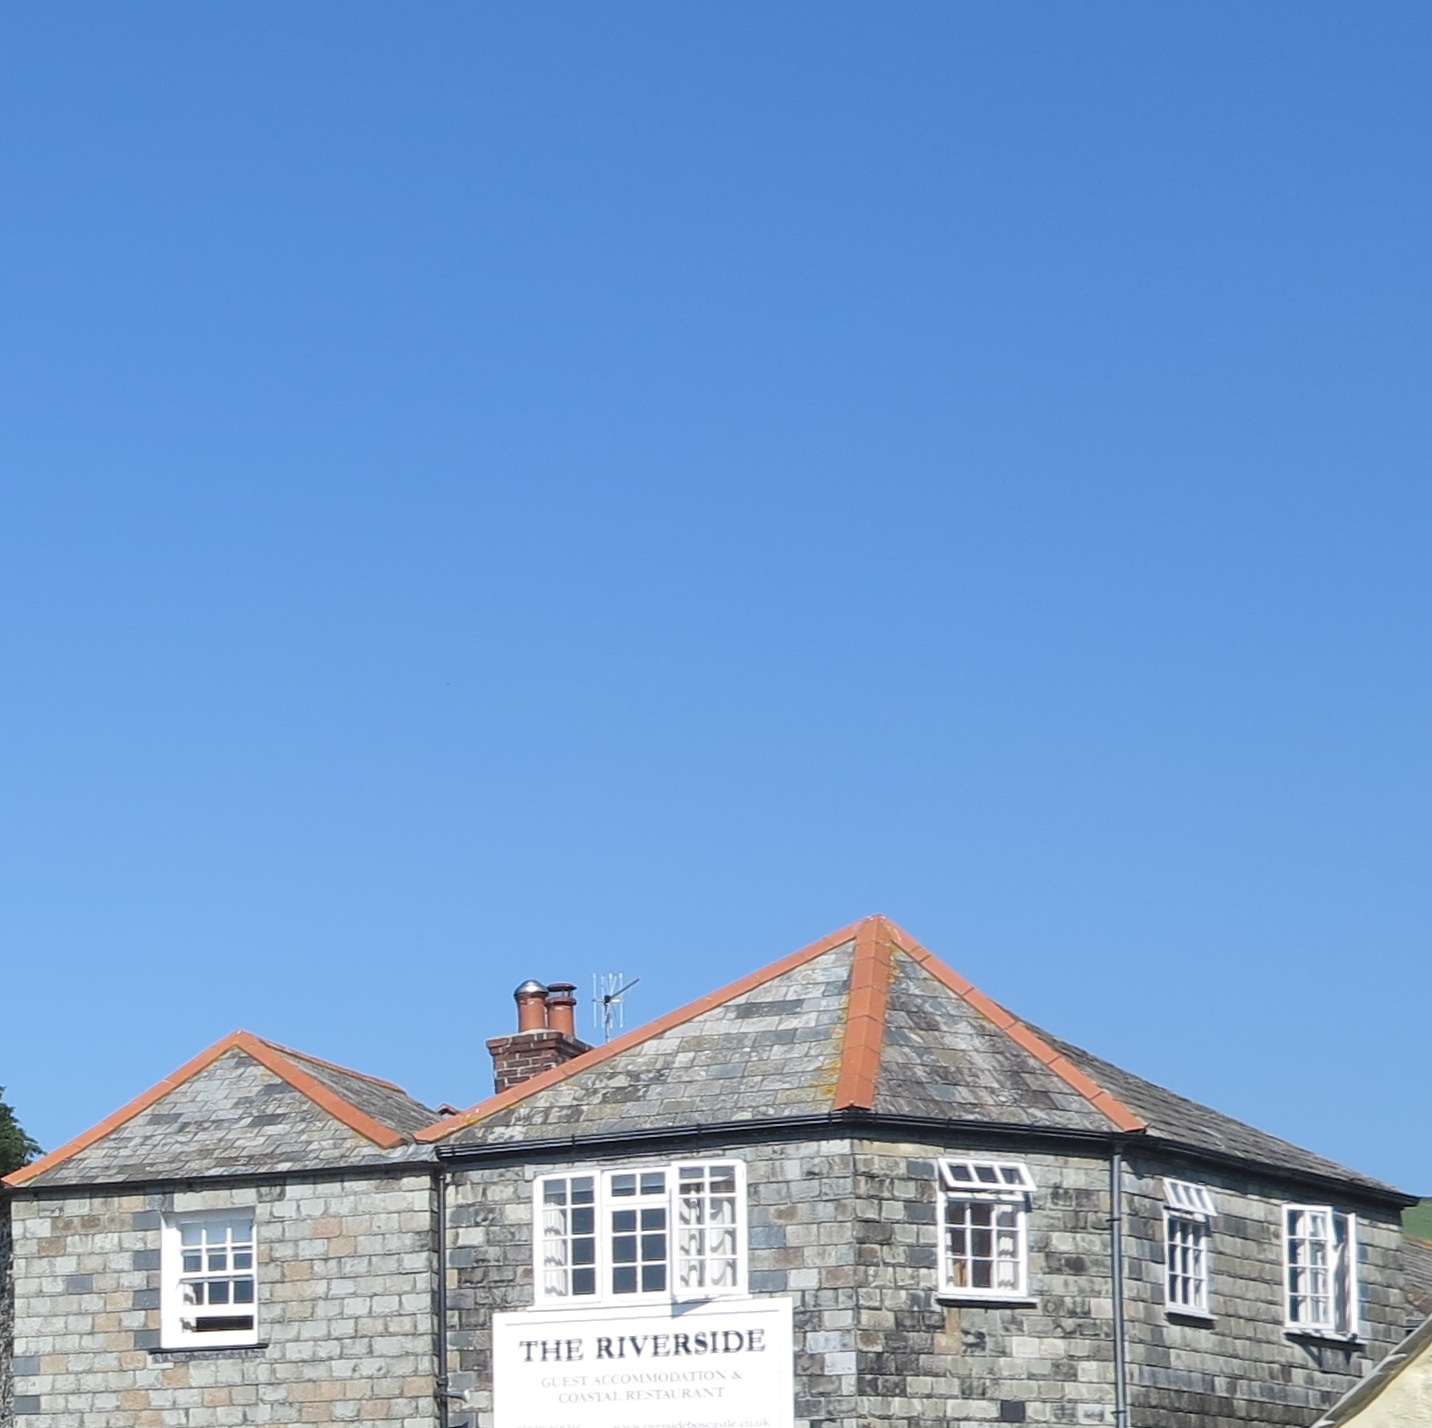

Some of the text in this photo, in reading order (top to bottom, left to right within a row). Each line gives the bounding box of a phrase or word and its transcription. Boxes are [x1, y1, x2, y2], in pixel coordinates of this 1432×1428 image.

[519, 1329, 767, 1362] THE RIVERSIDE
[540, 1370, 743, 1388] GUEST ACCOMMODATION &
[558, 1387, 726, 1404] COASTAL RESTAURANT
